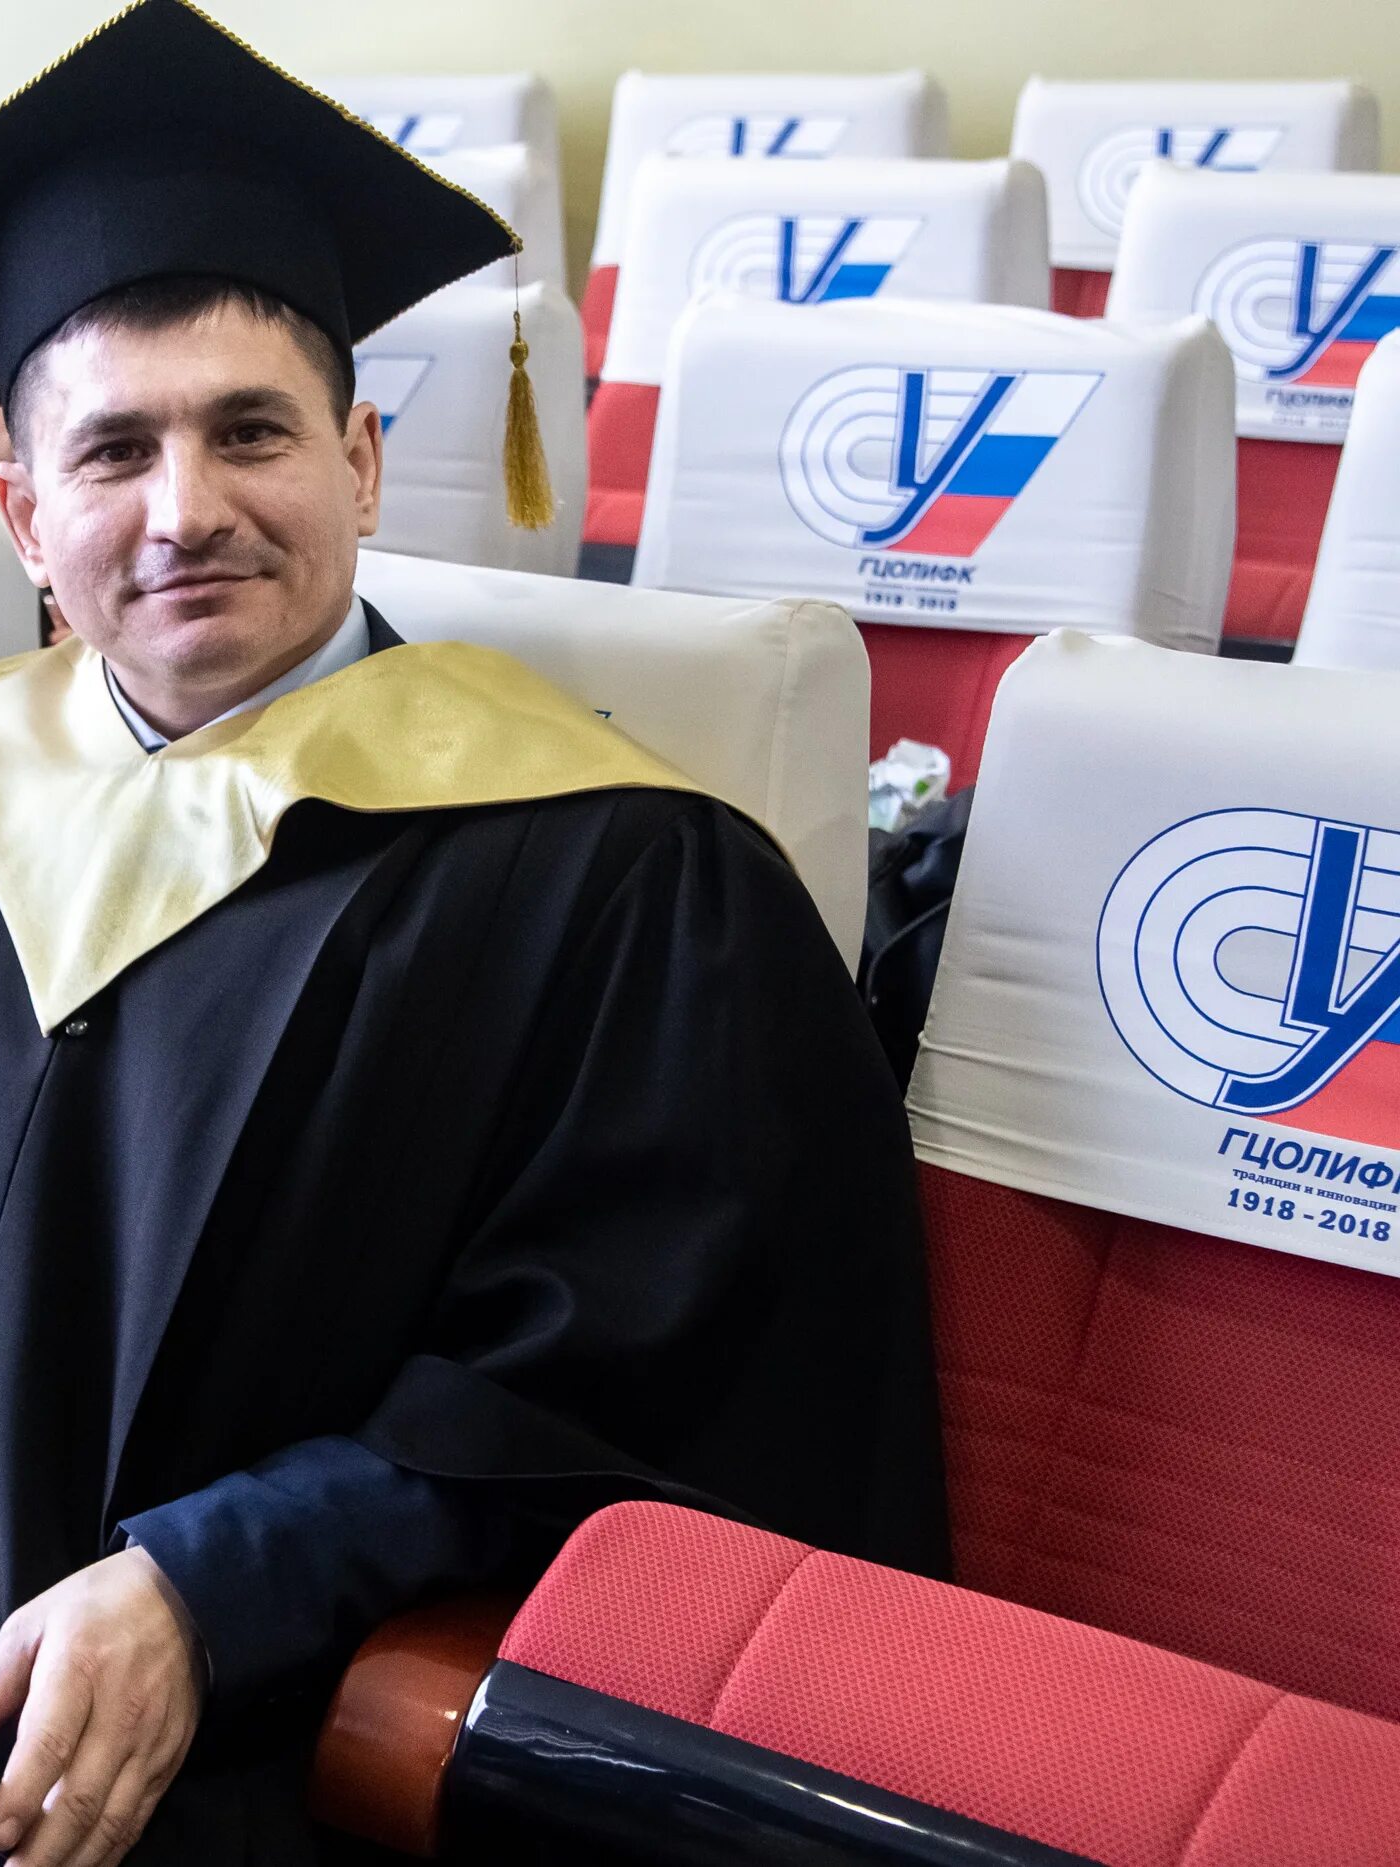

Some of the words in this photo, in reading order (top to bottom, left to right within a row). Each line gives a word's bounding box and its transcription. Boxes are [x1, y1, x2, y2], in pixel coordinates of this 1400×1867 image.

[1217, 1126, 1400, 1195] ГЦОЛИФ
[1232, 1168, 1302, 1193] традиции
[1304, 1185, 1314, 1195] и
[1317, 1187, 1398, 1214] инновации
